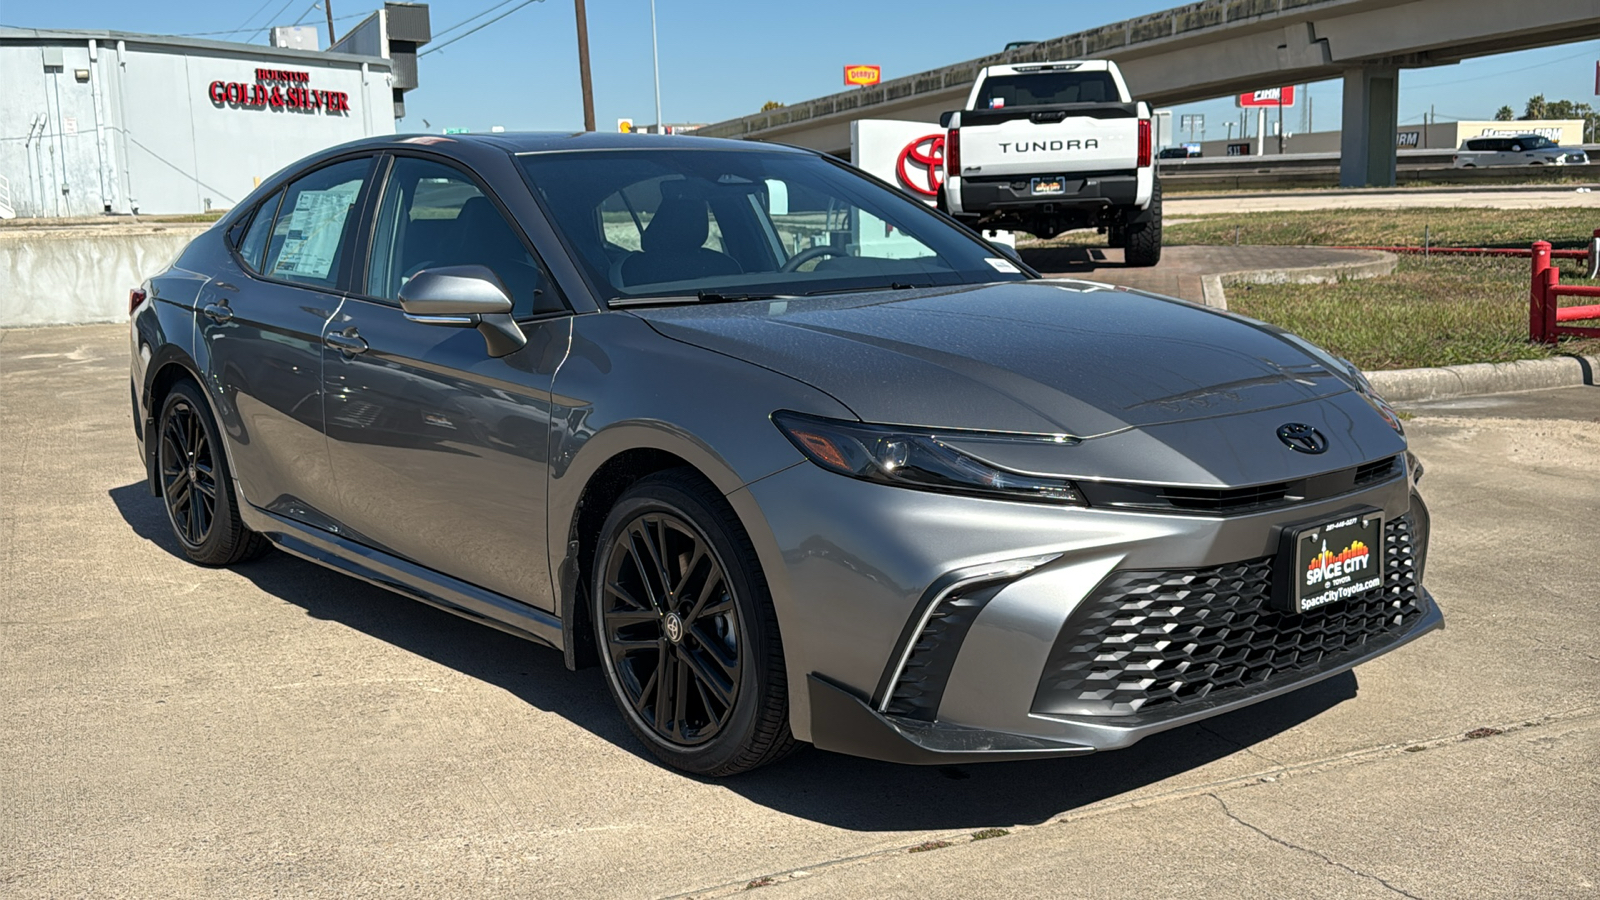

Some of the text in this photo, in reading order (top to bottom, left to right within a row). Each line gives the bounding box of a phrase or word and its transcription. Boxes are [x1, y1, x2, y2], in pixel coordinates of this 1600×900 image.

[255, 68, 309, 82] HOUSTON
[851, 71, 875, 79] Denny's
[999, 139, 1098, 153] TUNDRA
[1307, 554, 1369, 585] SPACE CITY
[1332, 576, 1351, 585] TOYOTA
[1301, 577, 1380, 610] SpaceCityToyota.com
